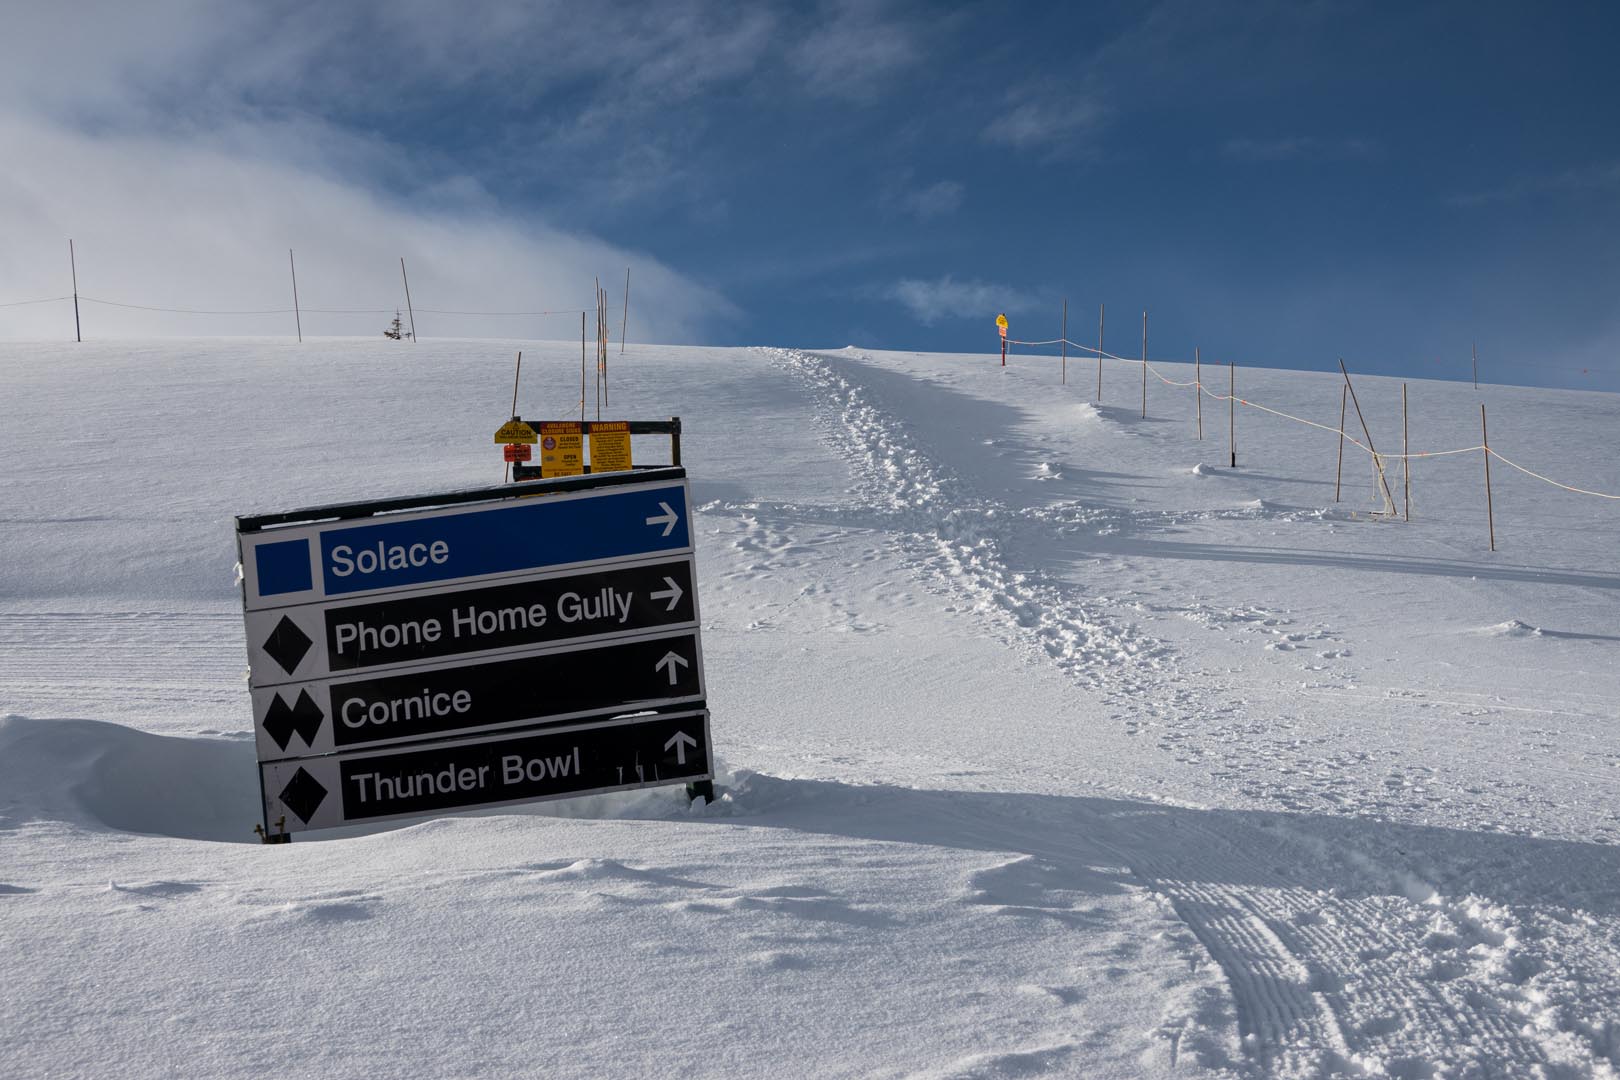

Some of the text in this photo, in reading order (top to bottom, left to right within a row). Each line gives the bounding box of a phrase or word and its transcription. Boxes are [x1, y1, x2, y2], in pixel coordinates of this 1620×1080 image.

[592, 422, 626, 432] WARNING
[331, 540, 449, 577] Solace
[335, 587, 633, 654] Phone Home Gully
[341, 688, 472, 728] Cornice
[350, 746, 580, 802] Thunder Bowl
